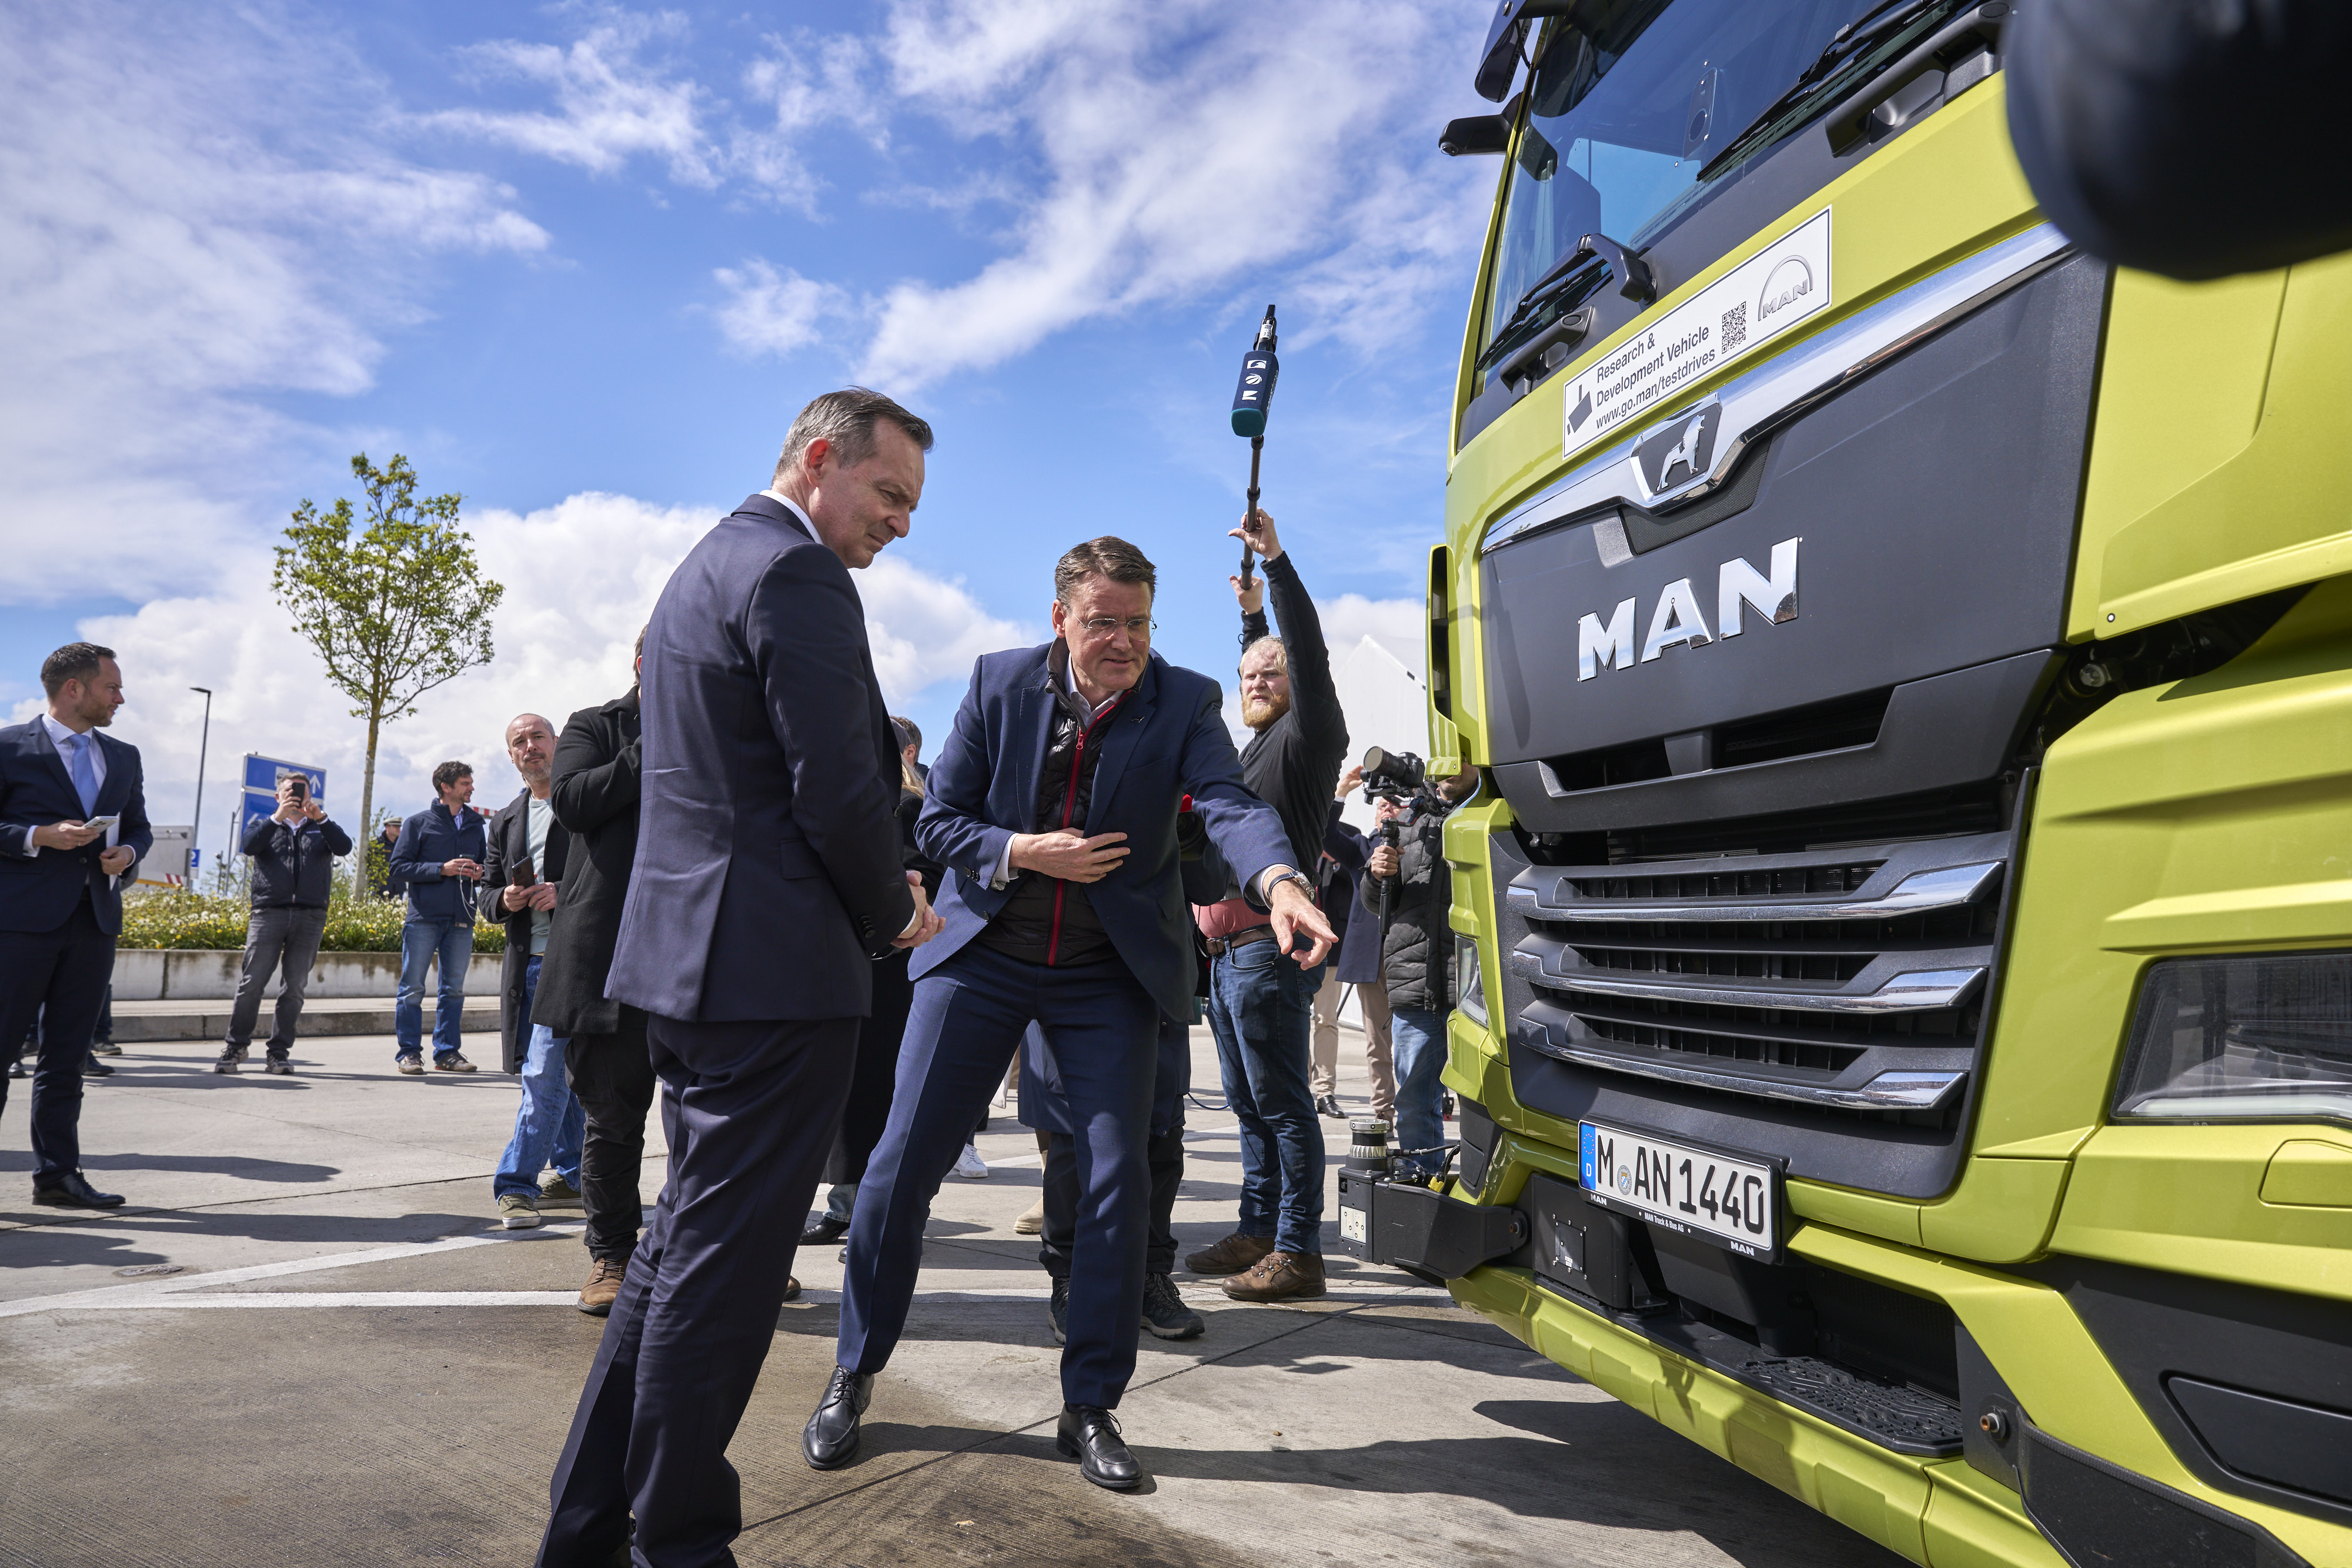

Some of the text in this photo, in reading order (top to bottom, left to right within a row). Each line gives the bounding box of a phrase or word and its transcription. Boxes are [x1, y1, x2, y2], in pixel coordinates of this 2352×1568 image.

[1762, 279, 1808, 319] MAN
[1596, 332, 1655, 383] Research &
[1596, 326, 1709, 407] Development Vehicle
[1596, 349, 1716, 429] www.go.man/testdrives
[1578, 536, 1799, 682] MAN
[1586, 1162, 1592, 1177] D
[1597, 1135, 1613, 1187] M
[1590, 1193, 1607, 1206] MAN
[1644, 1212, 1654, 1222] MAN
[1653, 1215, 1665, 1226] Truck
[1669, 1221, 1678, 1231] Bus
[1678, 1223, 1684, 1232] AG
[1730, 1241, 1754, 1256] MAN
